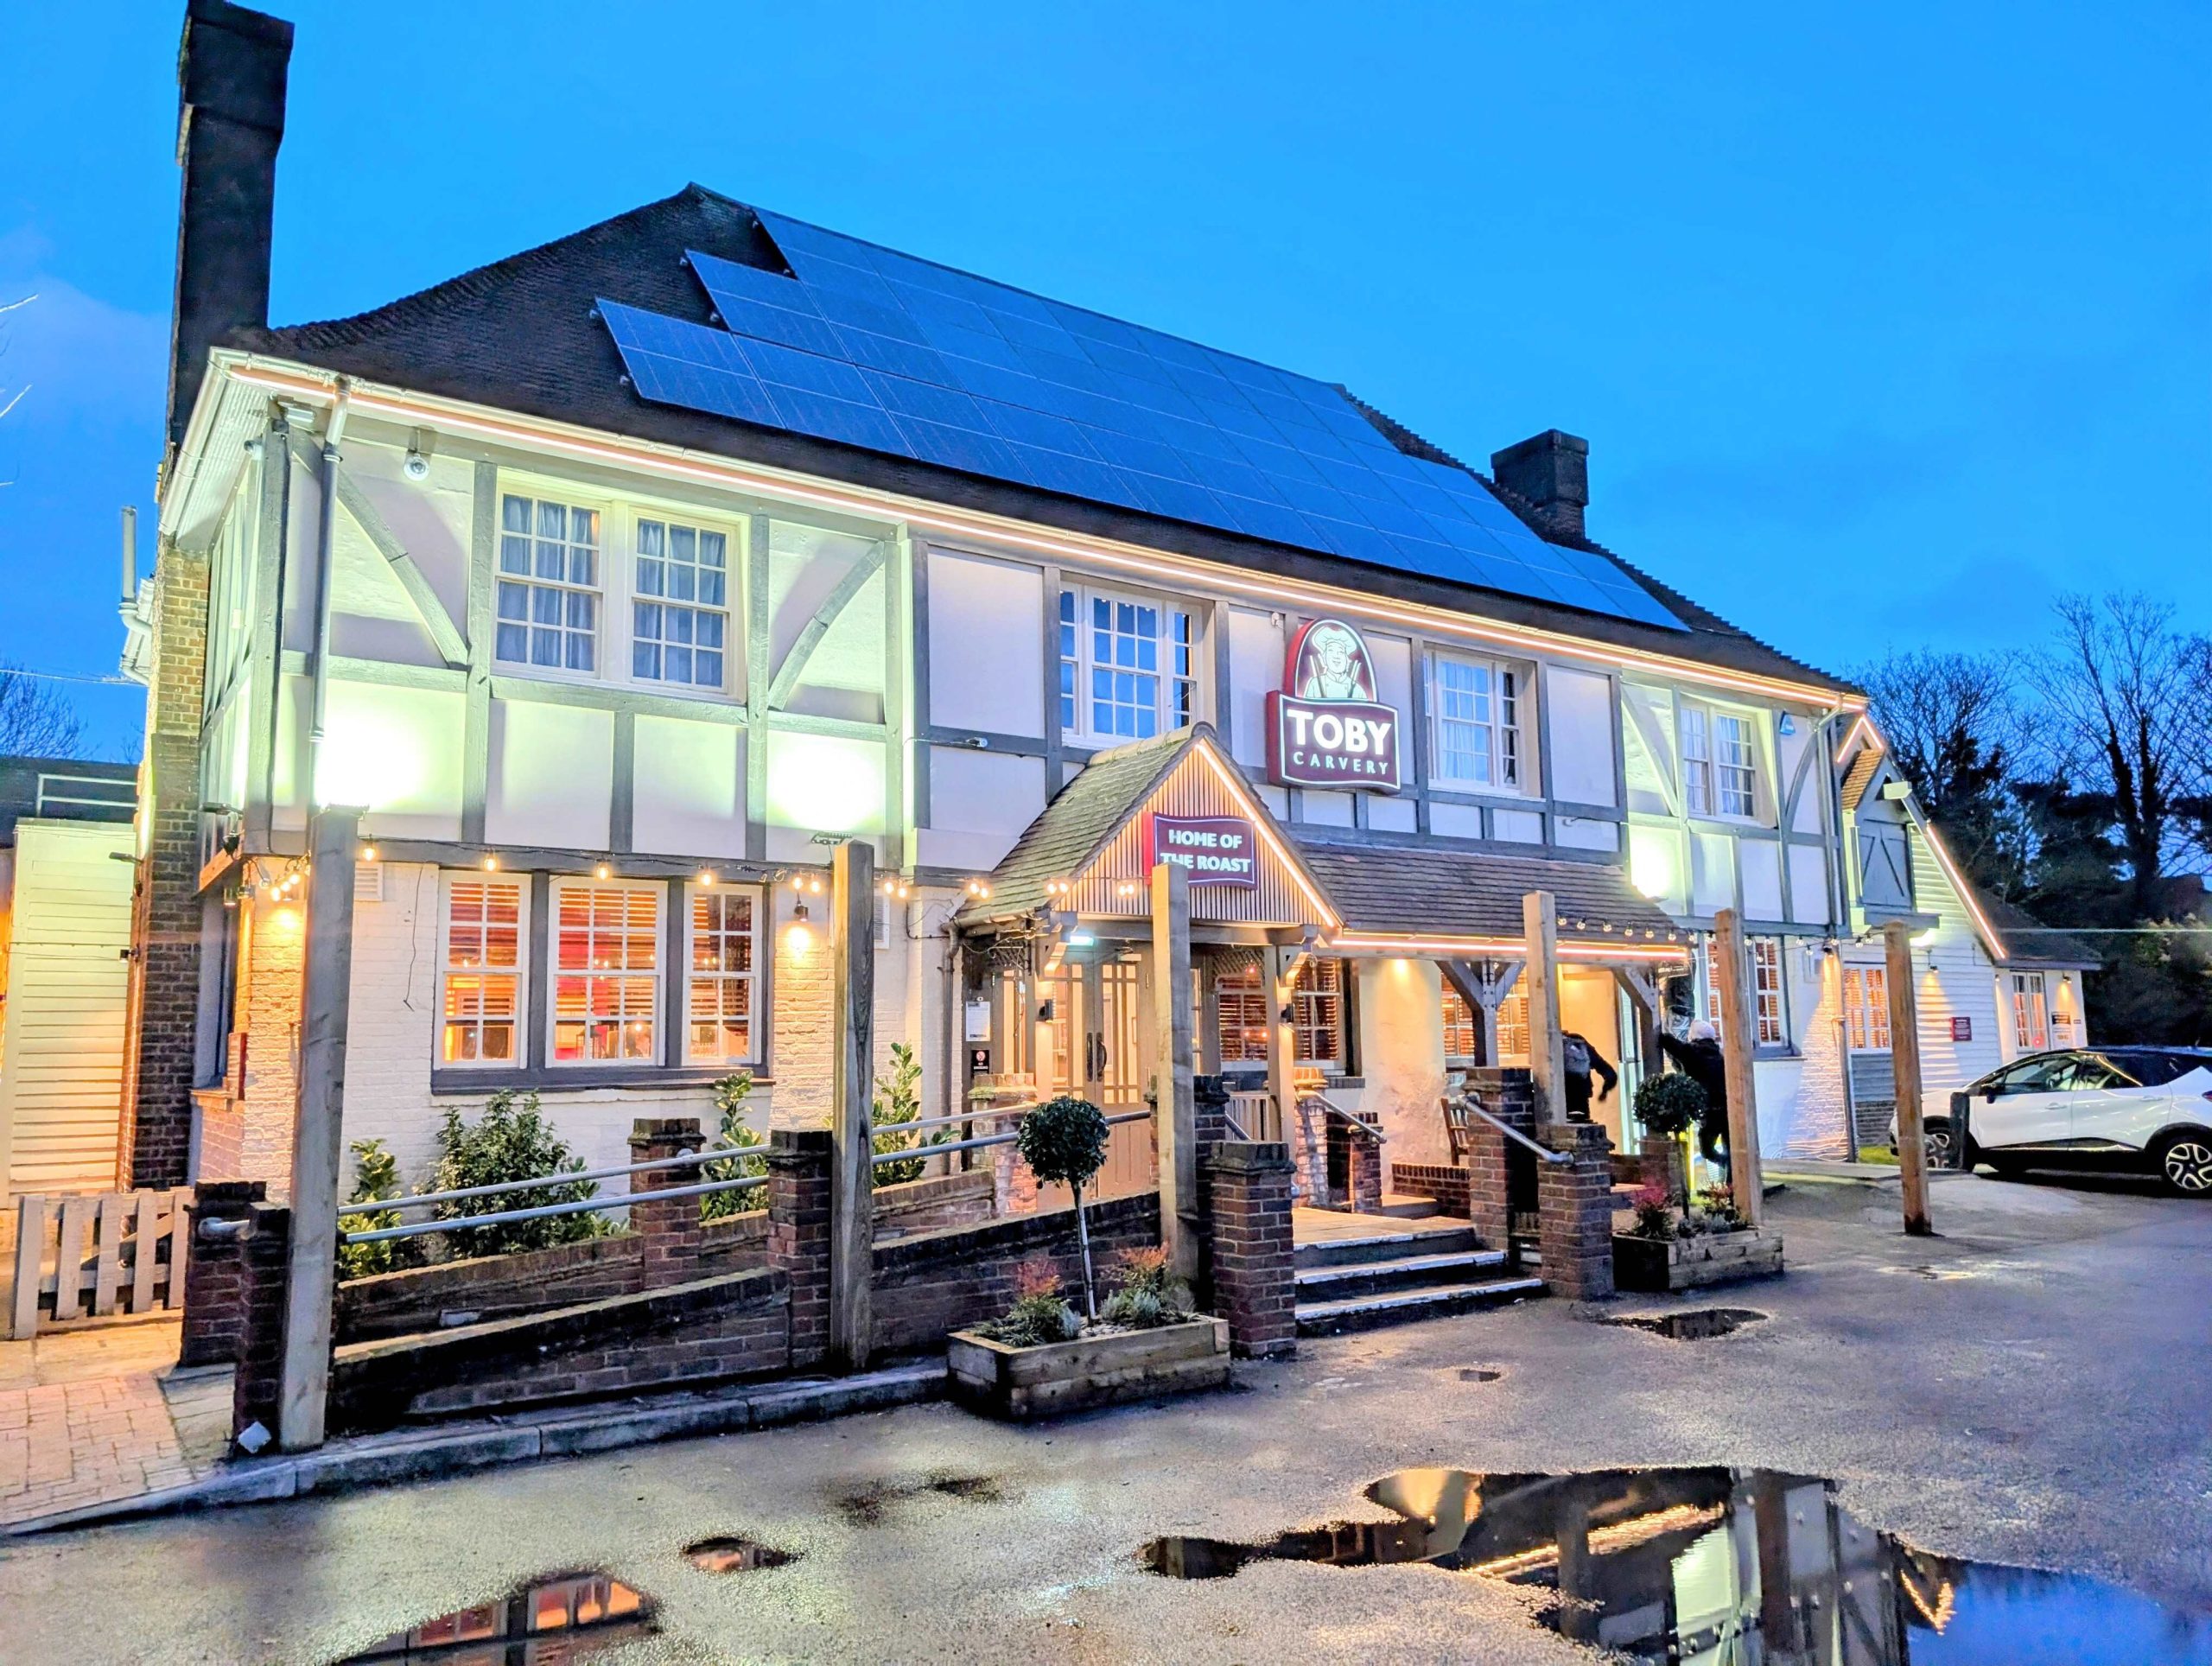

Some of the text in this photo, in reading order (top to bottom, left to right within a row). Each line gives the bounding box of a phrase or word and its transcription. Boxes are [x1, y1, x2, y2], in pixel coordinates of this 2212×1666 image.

[1287, 709, 1391, 755] TOBY
[1293, 751, 1389, 775] CARVERY
[1168, 829, 1243, 849] HOME OF
[1197, 855, 1251, 873] ROAST
